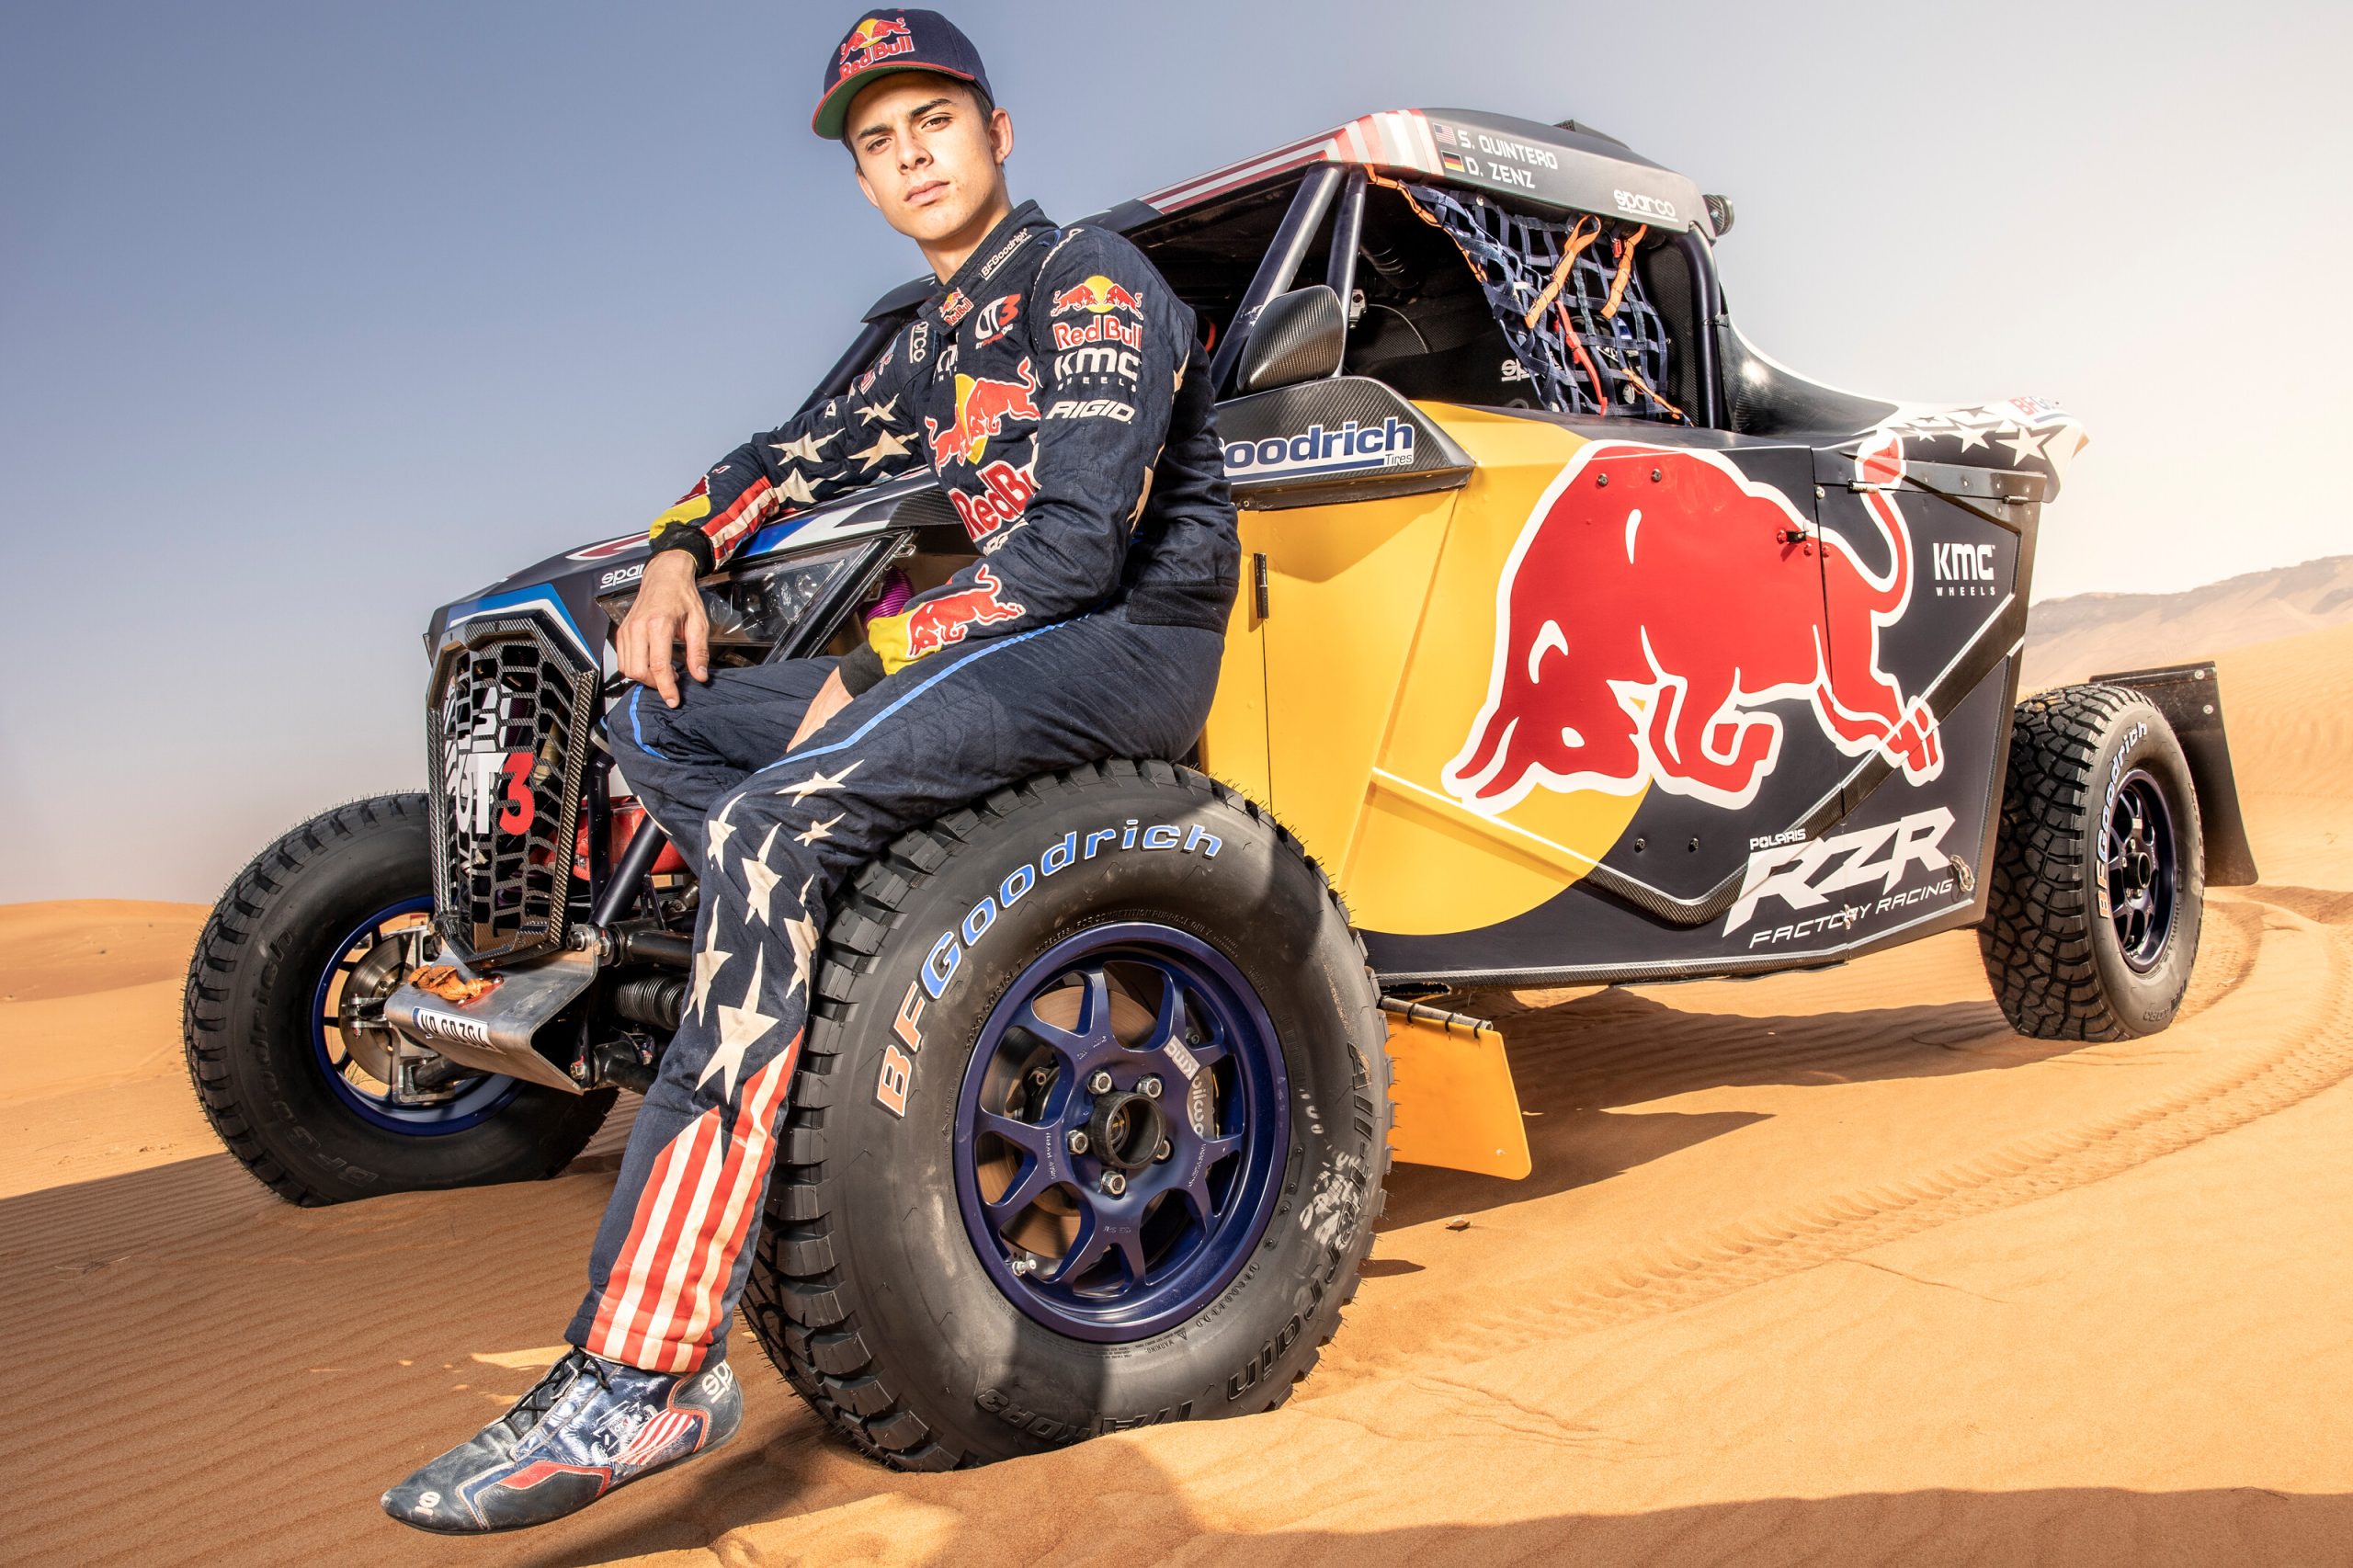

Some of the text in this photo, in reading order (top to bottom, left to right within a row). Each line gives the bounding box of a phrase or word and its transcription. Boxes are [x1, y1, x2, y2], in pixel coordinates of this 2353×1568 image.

[839, 36, 915, 80] Red Bull
[1458, 131, 1559, 170] S. QUINTERO
[1464, 157, 1536, 189] D. ZENZ
[1614, 188, 1677, 221] sparco
[1052, 315, 1102, 351] Red
[1103, 314, 1142, 352] Bull
[1219, 417, 1414, 469] oodrich
[1385, 453, 1414, 467] Tires
[948, 470, 1022, 542] Red
[601, 563, 645, 588] spar
[1933, 542, 1996, 580] KMC
[1936, 585, 1996, 597] WHEELS
[2096, 721, 2148, 918] BFGoodrich
[1750, 828, 1807, 851] POLARIS
[1722, 806, 1956, 937] RZR
[1749, 879, 1954, 949] FACTORY RACING
[876, 818, 1223, 1119] BFGoodrich
